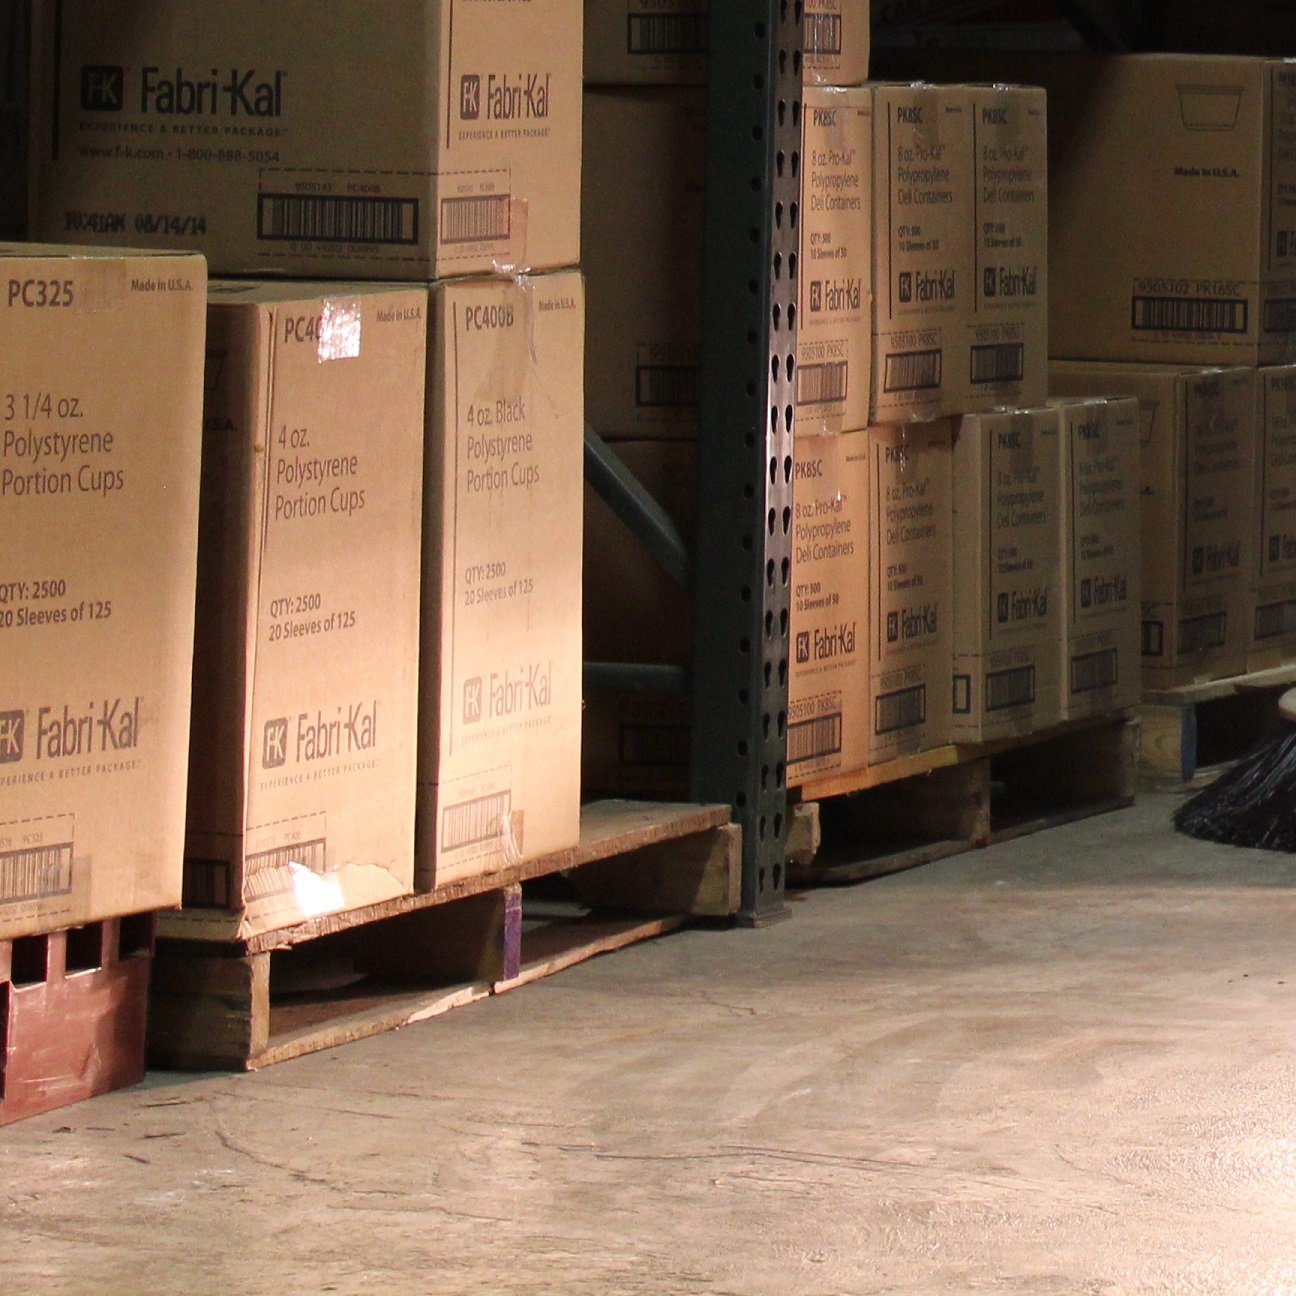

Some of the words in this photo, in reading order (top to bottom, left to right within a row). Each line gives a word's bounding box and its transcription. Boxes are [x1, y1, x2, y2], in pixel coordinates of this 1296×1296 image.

[79, 121, 154, 135] EXPERIENCE
[172, 124, 219, 136] BETTER
[8, 279, 75, 308] PC325
[130, 277, 157, 293] Made
[157, 278, 167, 292] in
[167, 278, 194, 292] U.S.A.
[4, 393, 15, 421] 3
[23, 391, 53, 421] 1/4
[57, 397, 84, 420] oz.
[466, 404, 475, 427] 4
[495, 396, 526, 424] Black
[3, 429, 114, 464] Polystyrene
[278, 424, 287, 449] 4
[290, 427, 311, 449] oz.
[467, 431, 533, 465] Polystyrene
[1, 467, 72, 497] Portion
[77, 464, 125, 498] Cups
[276, 454, 359, 489] Polystyrene
[467, 465, 508, 494] Portion
[511, 461, 540, 492] Cups
[794, 458, 823, 479] PK8SC
[274, 491, 327, 522] Portion
[329, 486, 366, 518] Cups
[0, 582, 30, 604] QTY:
[32, 579, 67, 600] 2500
[269, 596, 295, 620] QTY:
[295, 592, 322, 614] 2500
[16, 605, 67, 627] Sleeves
[70, 602, 85, 622] of
[87, 601, 112, 621] 125
[268, 624, 282, 643] 20
[283, 619, 322, 641] Sleeves
[323, 612, 335, 634] of
[335, 610, 356, 632] 125
